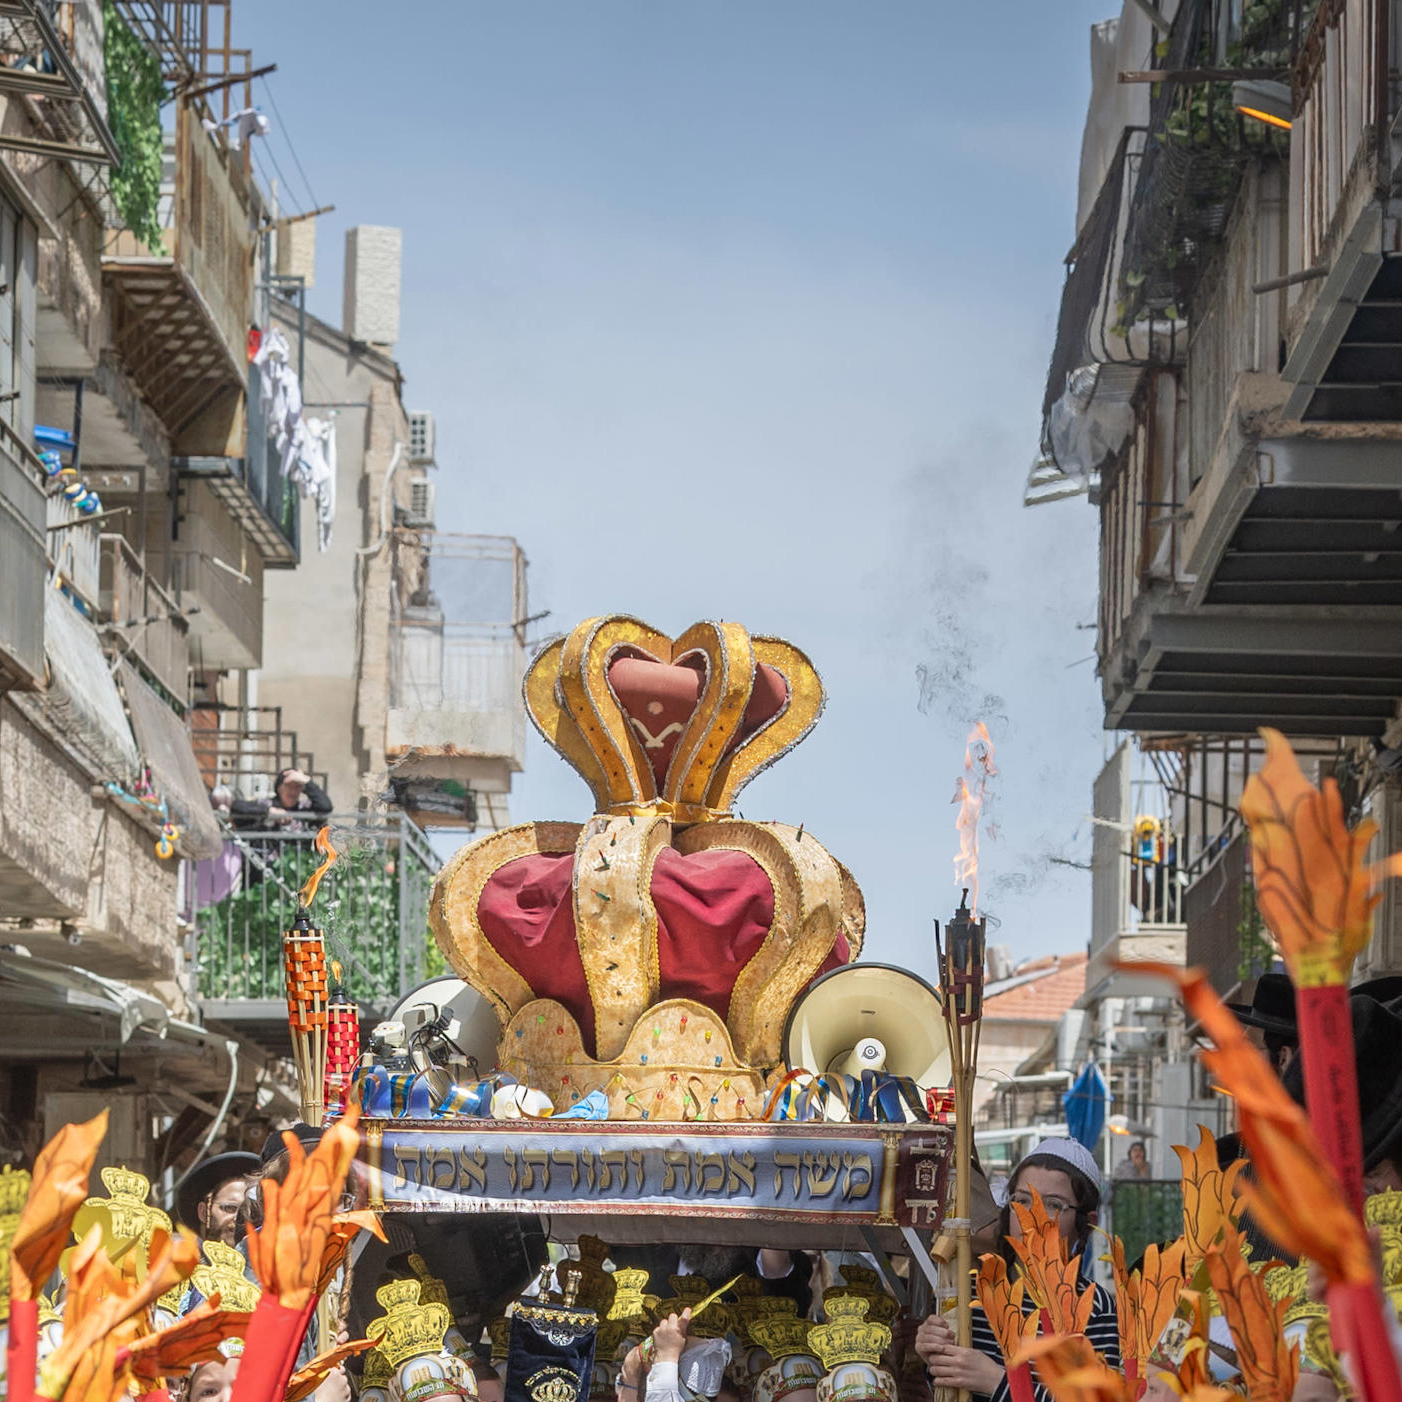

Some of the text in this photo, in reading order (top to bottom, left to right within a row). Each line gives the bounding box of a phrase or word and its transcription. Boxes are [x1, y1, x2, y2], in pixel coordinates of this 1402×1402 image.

[392, 1143, 874, 1201] משה אמת ותורתו אמת
